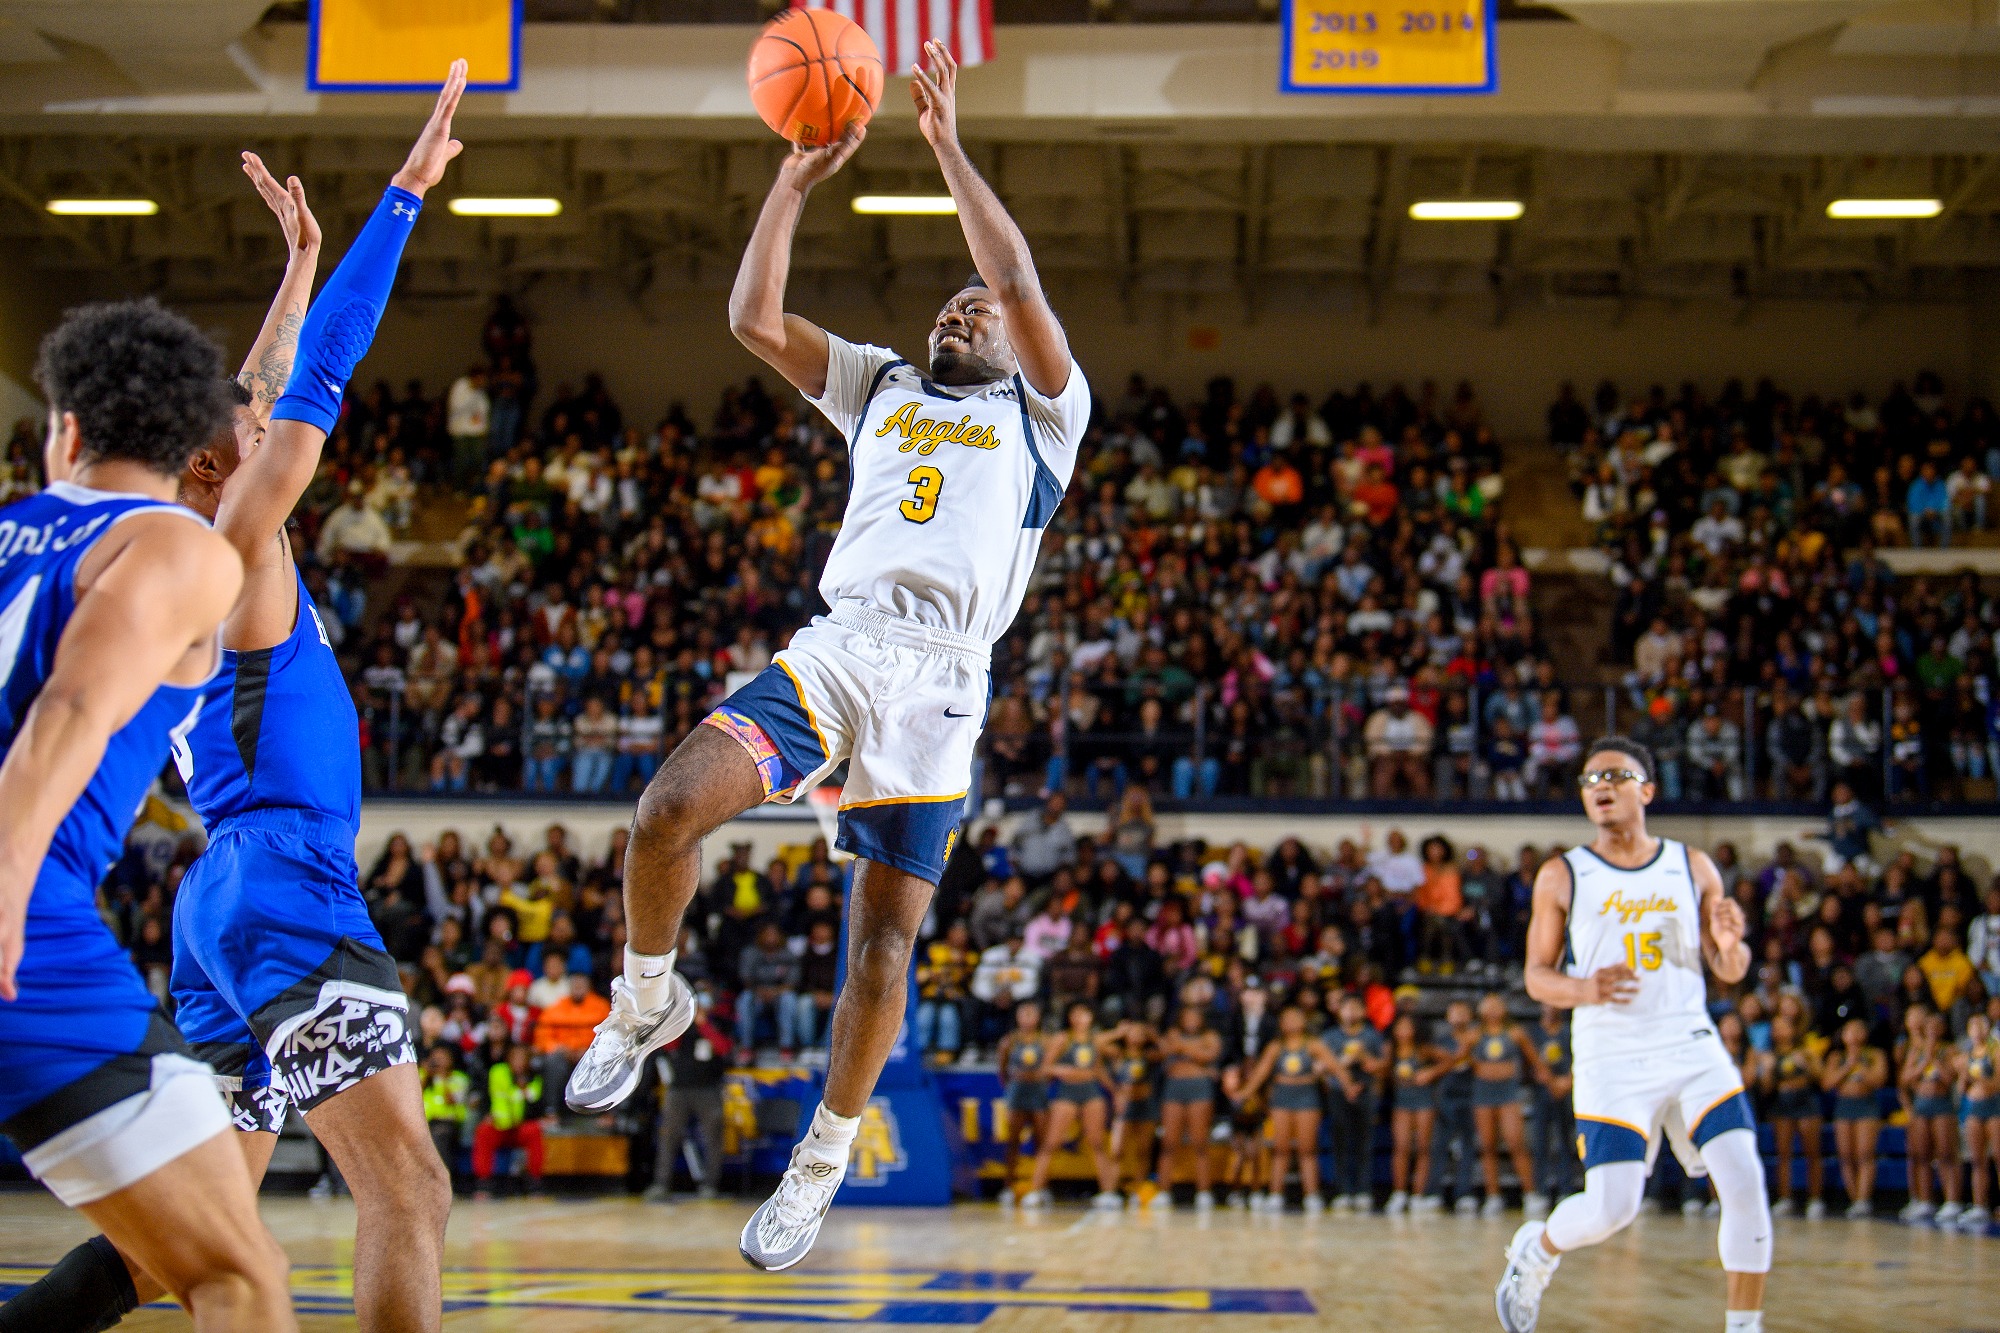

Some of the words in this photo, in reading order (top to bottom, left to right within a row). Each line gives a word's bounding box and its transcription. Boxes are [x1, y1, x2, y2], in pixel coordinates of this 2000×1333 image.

[1310, 48, 1380, 70] 2019
[875, 401, 1001, 456] Aggies
[898, 465, 945, 525] 3
[1598, 890, 1678, 924] Aggies
[1622, 931, 1663, 972] 15
